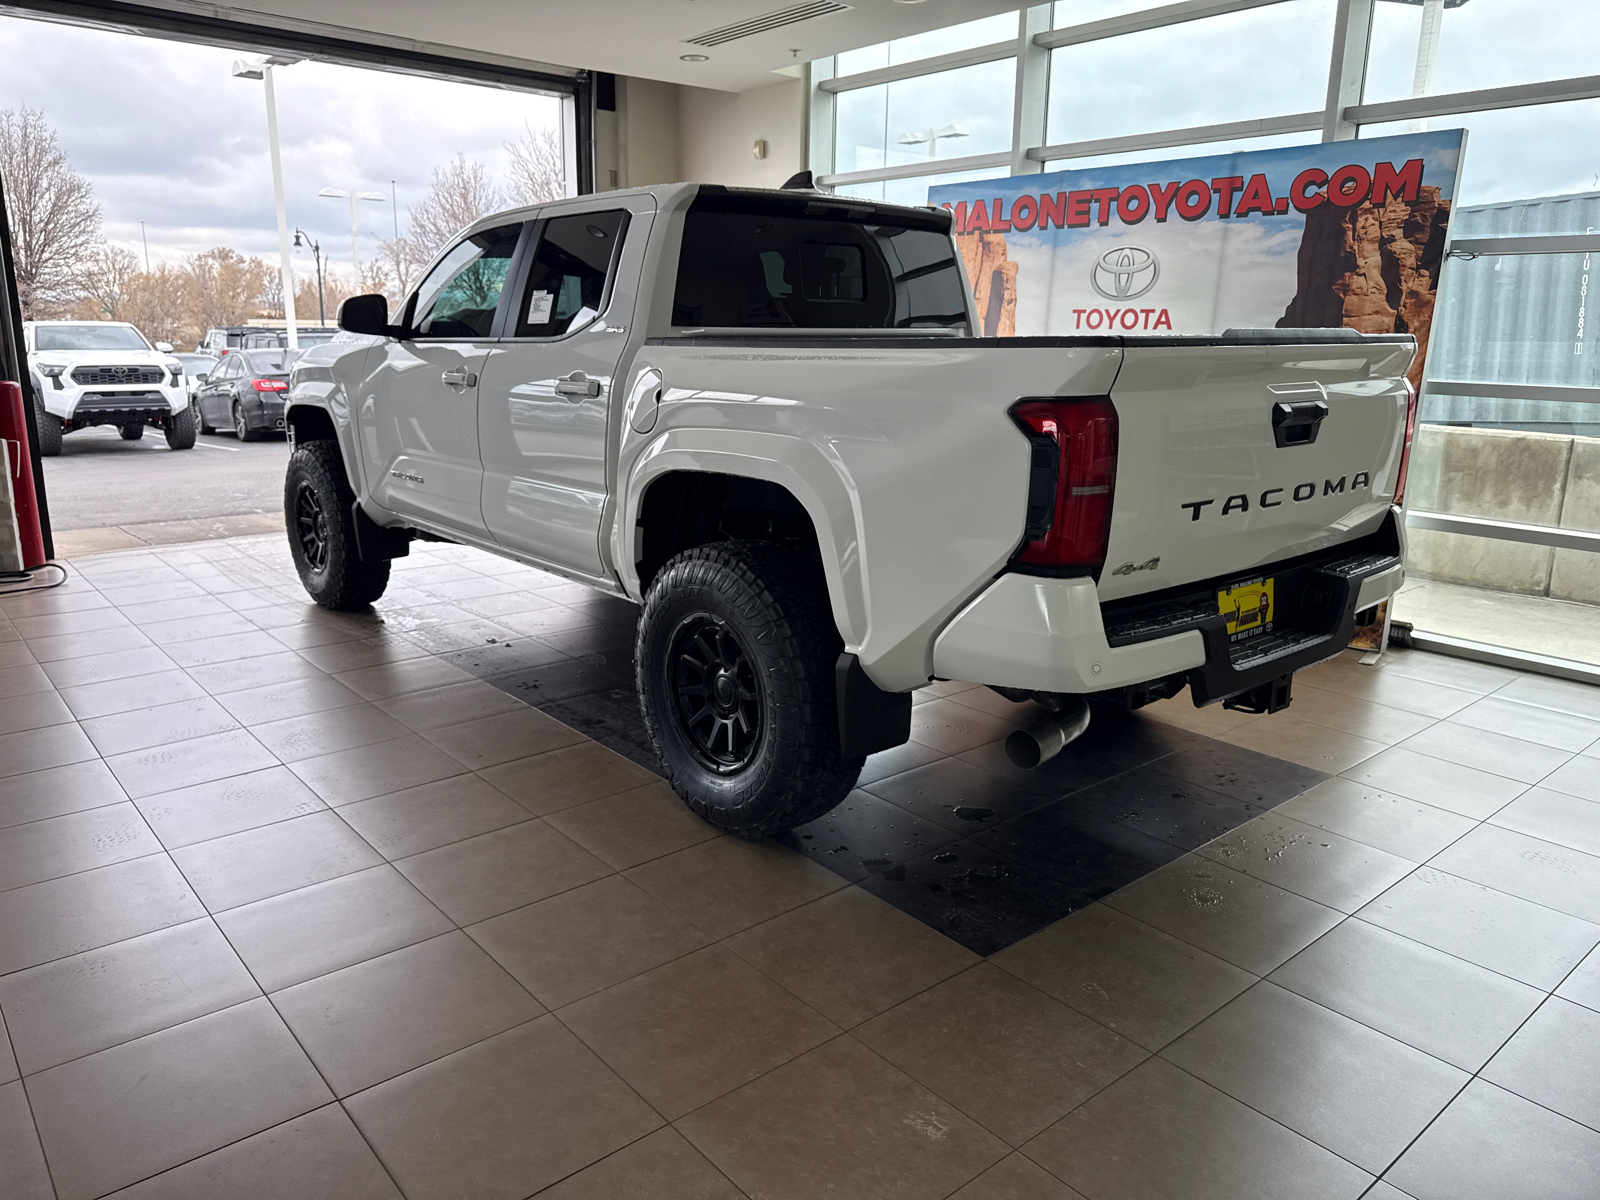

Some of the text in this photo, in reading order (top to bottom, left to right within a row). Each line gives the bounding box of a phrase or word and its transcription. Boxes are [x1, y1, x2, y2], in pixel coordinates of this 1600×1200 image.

[942, 158, 1425, 235] MALONETOYOTA.COM
[1072, 308, 1172, 331] TOYOTA
[1181, 470, 1370, 522] TACOMA
[1254, 626, 1264, 635] EASY
